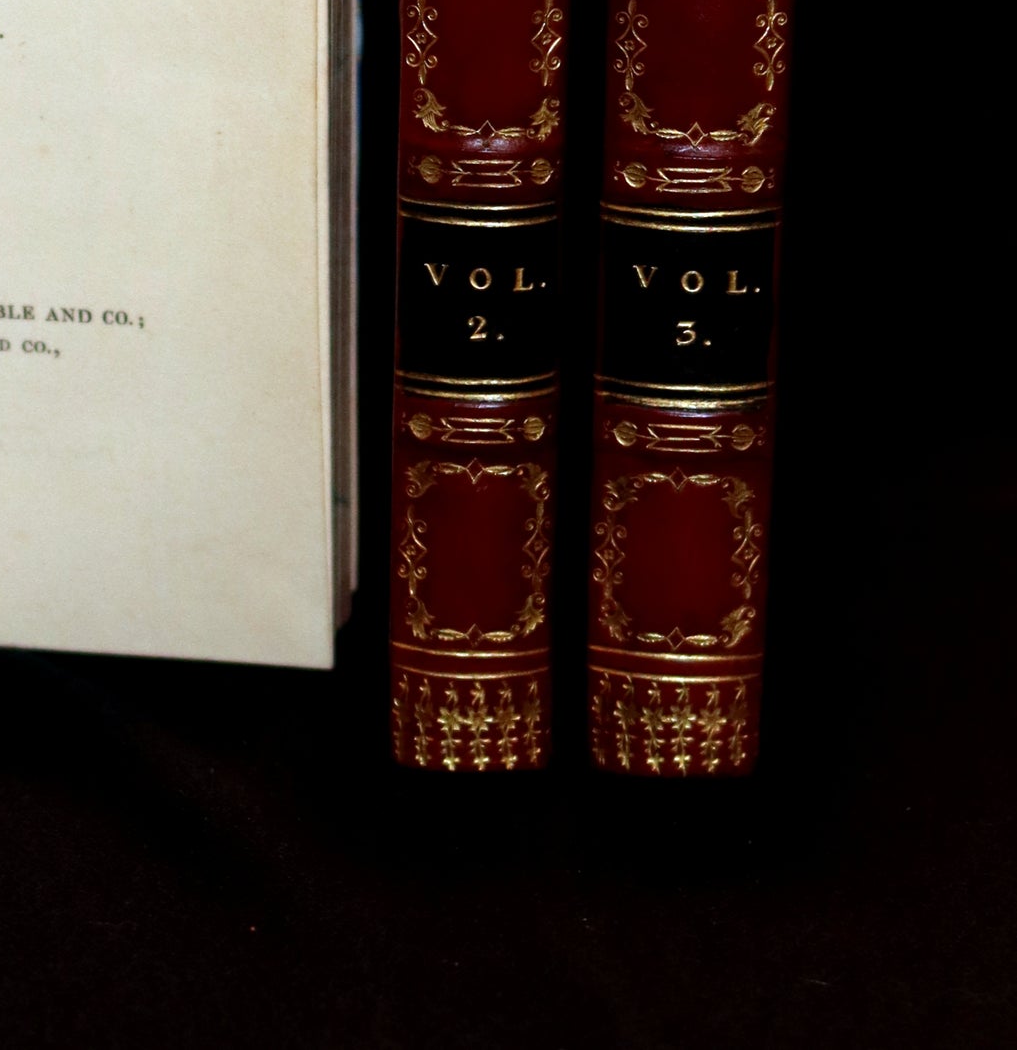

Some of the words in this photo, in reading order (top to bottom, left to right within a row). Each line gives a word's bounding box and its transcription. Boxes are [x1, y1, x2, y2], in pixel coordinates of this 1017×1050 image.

[424, 263, 547, 291] VOL.
[633, 265, 761, 294] VOL.
[45, 307, 93, 324] AND
[101, 309, 145, 330] CO.;
[468, 315, 505, 341] 2.
[675, 321, 711, 347] 3.
[21, 339, 61, 358] CO.,
